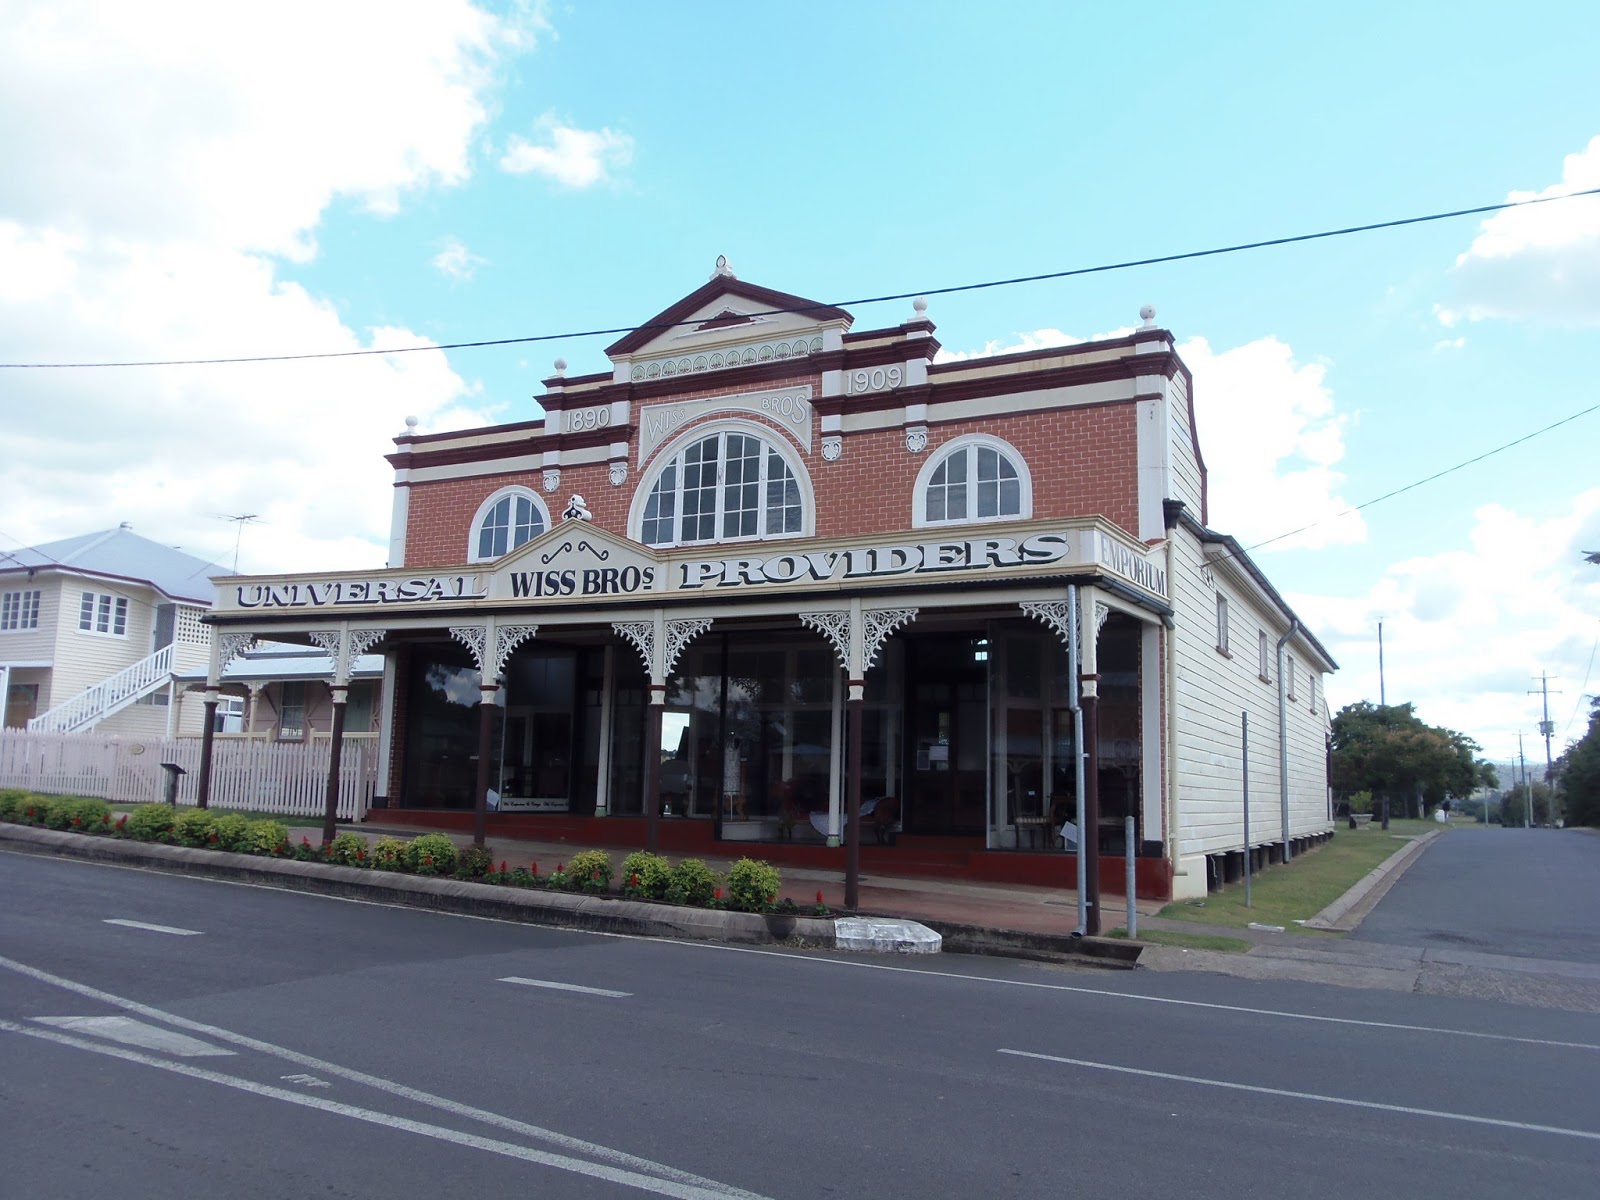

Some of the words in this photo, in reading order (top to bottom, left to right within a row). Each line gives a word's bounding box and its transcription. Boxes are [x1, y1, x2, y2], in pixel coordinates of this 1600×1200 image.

[847, 366, 902, 394] 1909
[565, 406, 610, 433] 1890
[679, 533, 1070, 589] PROVIDERS
[1100, 531, 1165, 596] EMPORIUM
[236, 576, 488, 608] UNIVERSAL
[510, 571, 576, 598] WISS
